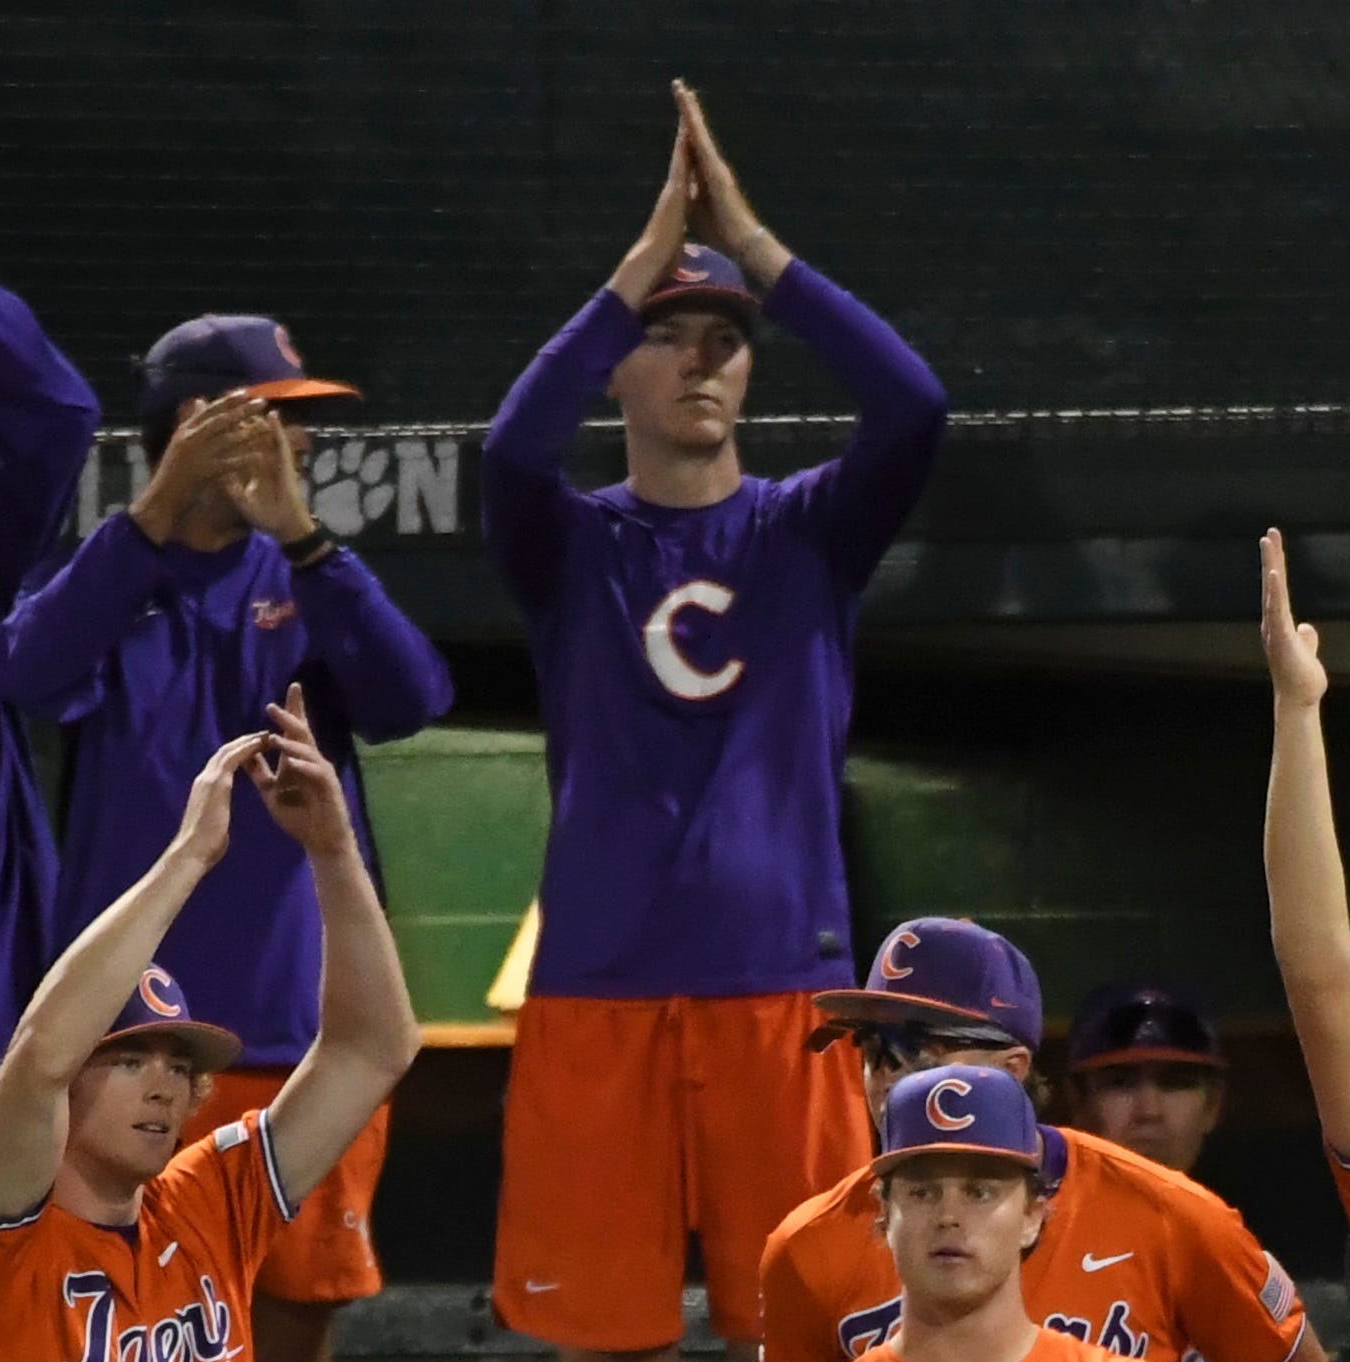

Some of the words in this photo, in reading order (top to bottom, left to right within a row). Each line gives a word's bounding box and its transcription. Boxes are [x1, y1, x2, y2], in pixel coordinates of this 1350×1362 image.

[642, 579, 745, 701] C
[881, 932, 921, 980] C
[139, 969, 182, 1018] C
[925, 1078, 976, 1131] C
